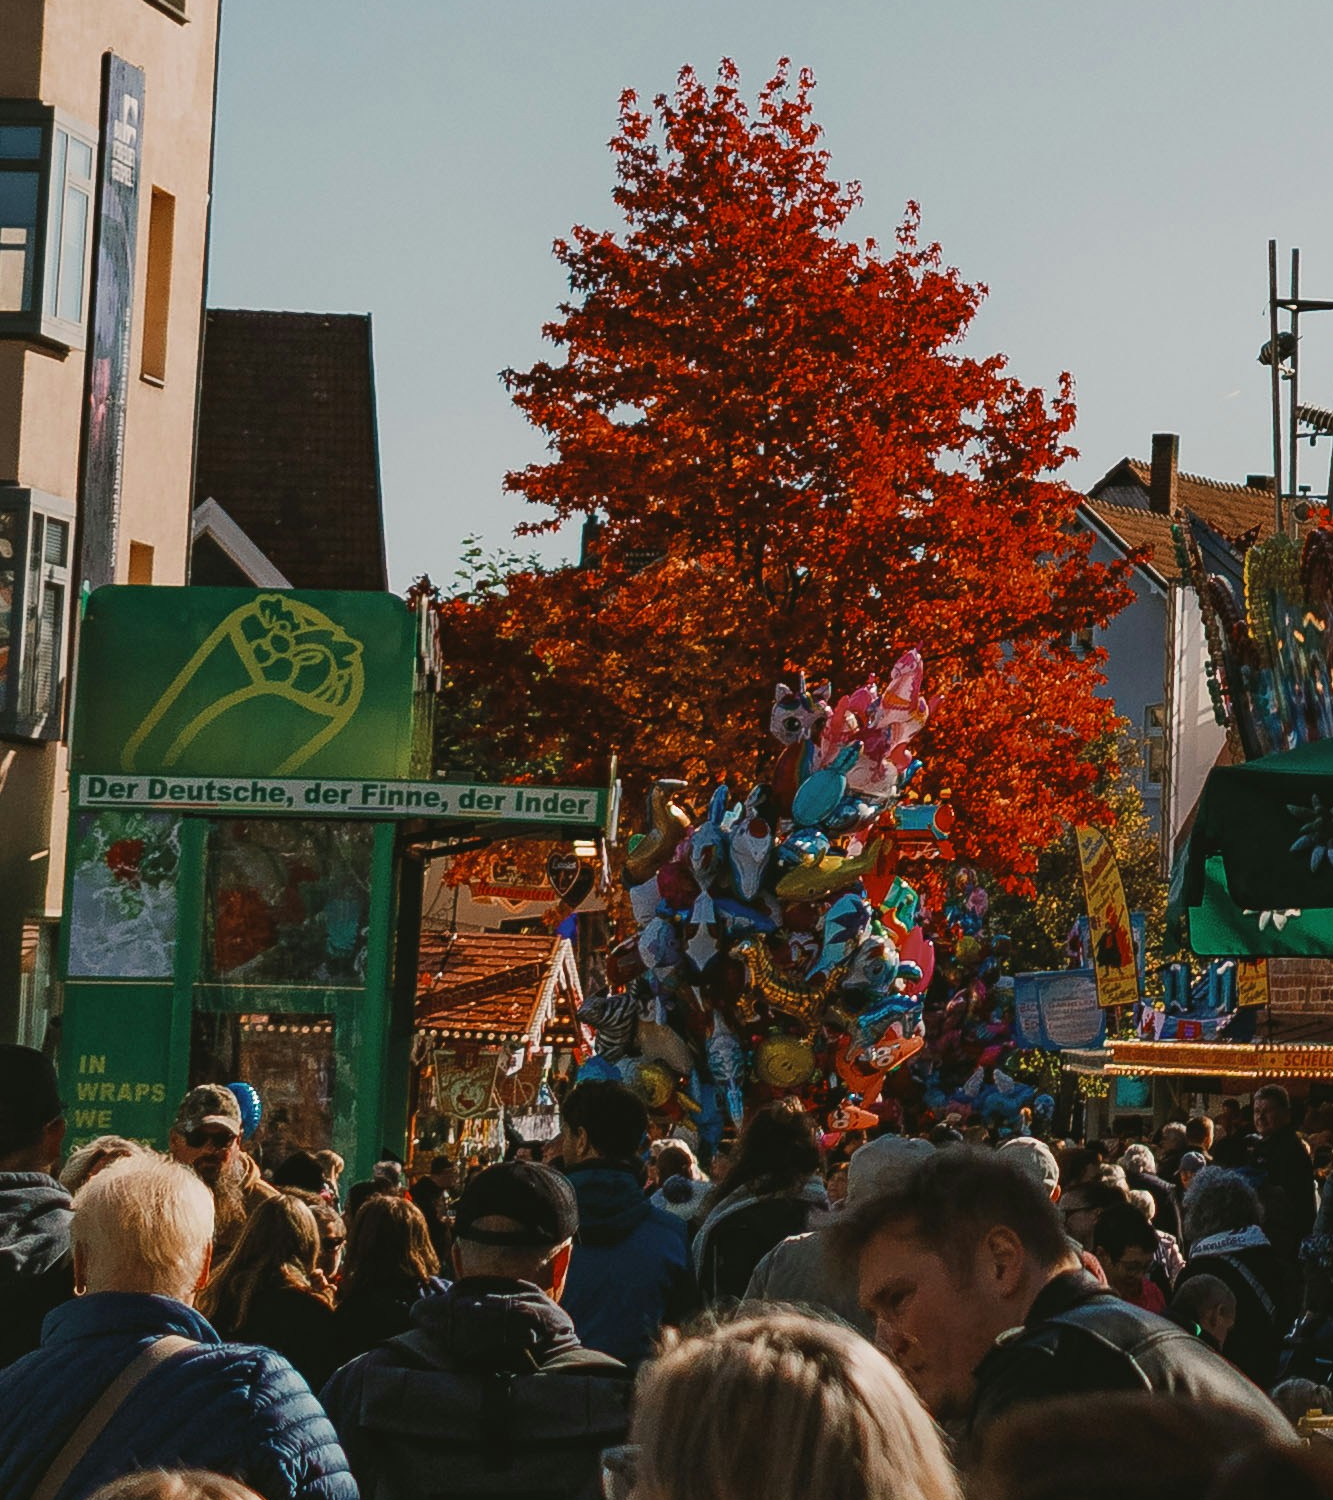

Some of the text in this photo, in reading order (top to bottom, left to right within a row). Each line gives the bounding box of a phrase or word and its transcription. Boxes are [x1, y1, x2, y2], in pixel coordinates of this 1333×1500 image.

[87, 776, 592, 817] Der Deutsche, der Finne, der Inder
[79, 1054, 107, 1074] IN
[77, 1082, 166, 1104] WRAPS
[74, 1108, 113, 1130] WE
